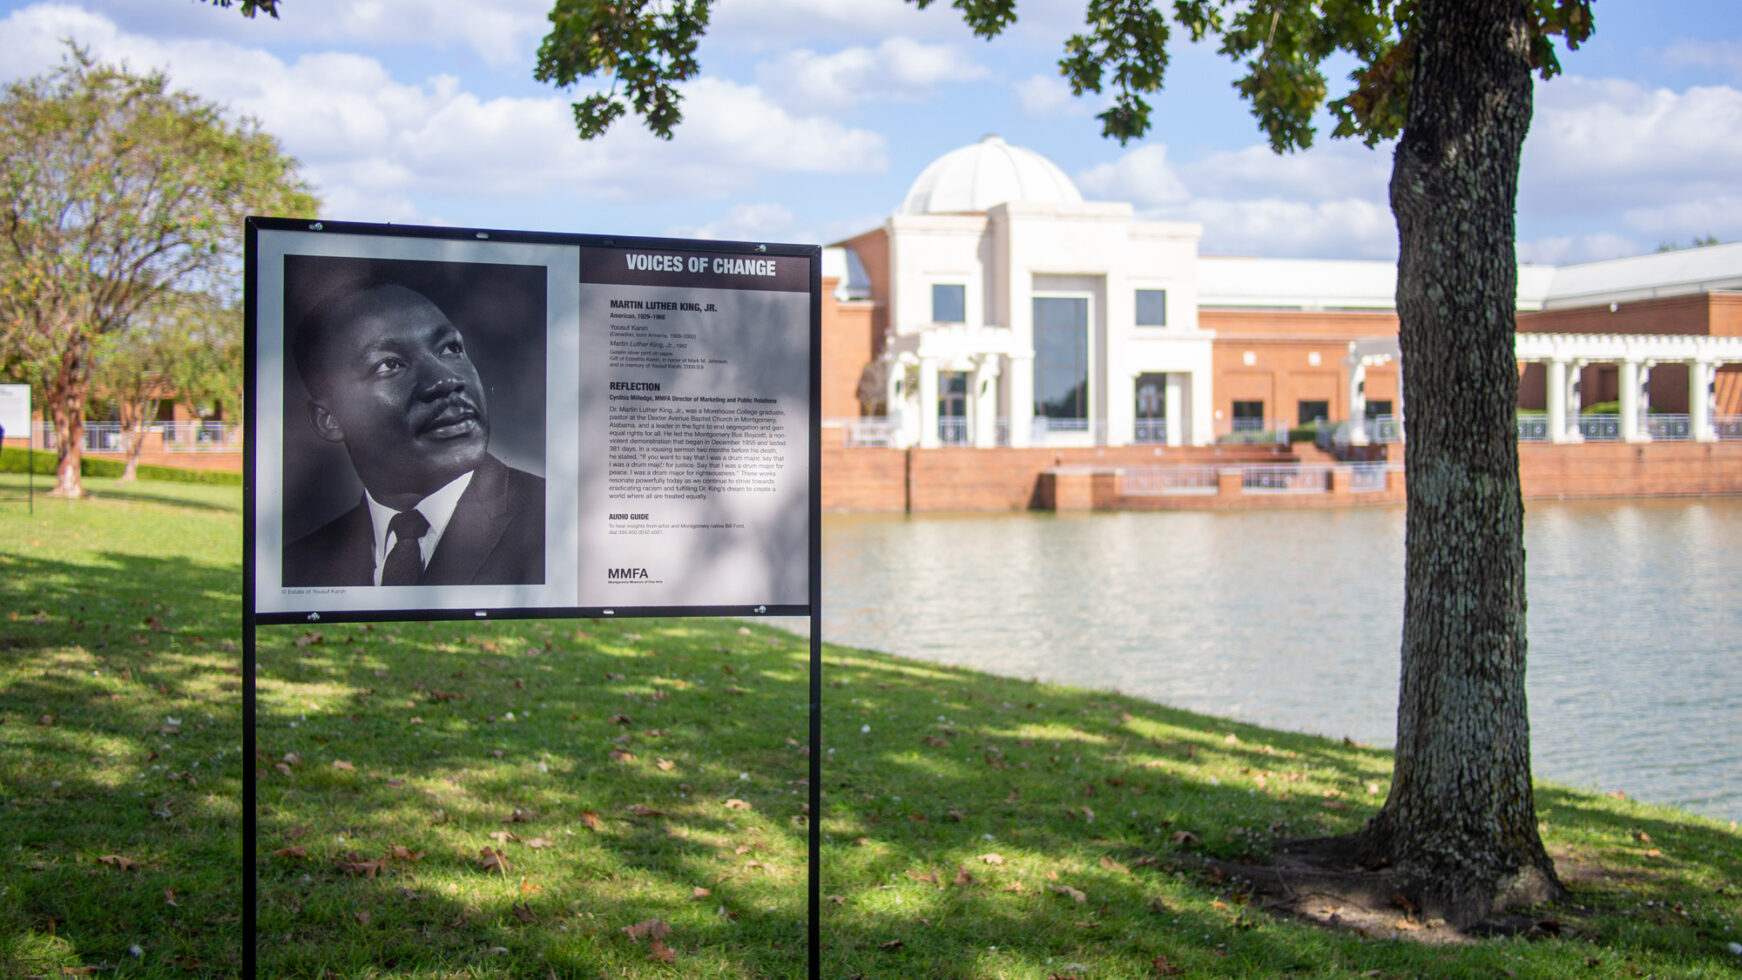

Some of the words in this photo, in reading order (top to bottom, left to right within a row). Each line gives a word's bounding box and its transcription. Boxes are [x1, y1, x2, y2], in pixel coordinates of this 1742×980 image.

[626, 254, 683, 272] VOICES
[688, 257, 709, 273] OF
[713, 258, 776, 276] CHANGE
[610, 300, 643, 309] MARTIN
[646, 301, 678, 310] LUTHER
[680, 303, 702, 312] KING,
[704, 304, 718, 312] JR.
[610, 382, 660, 391] REFLECTION
[608, 568, 648, 579] MMFA
